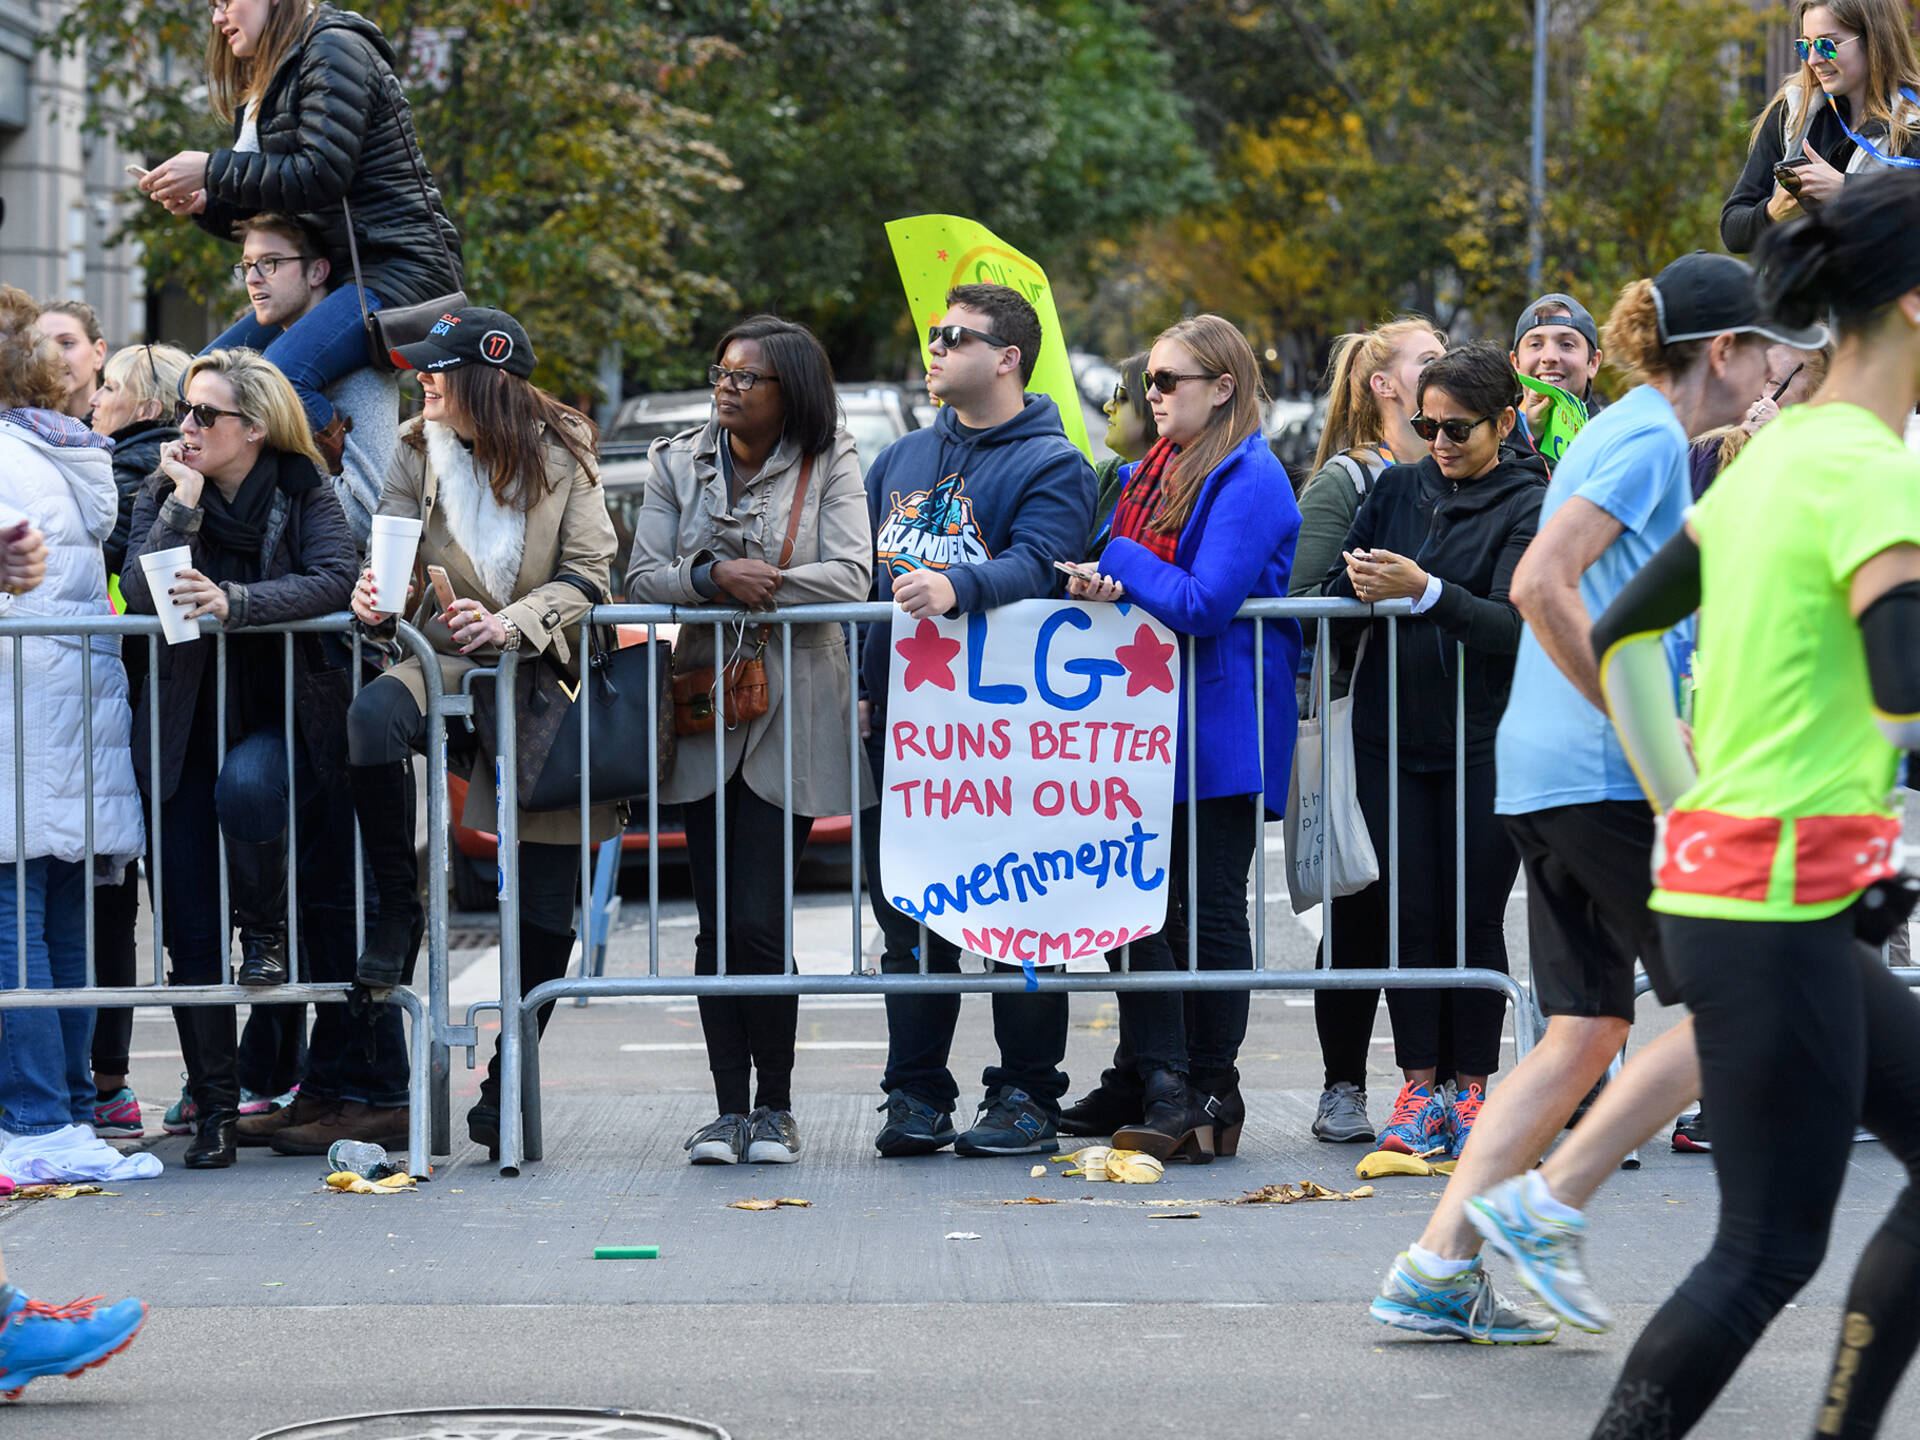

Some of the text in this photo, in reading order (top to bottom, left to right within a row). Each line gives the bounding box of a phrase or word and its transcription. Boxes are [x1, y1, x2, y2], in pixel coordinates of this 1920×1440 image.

[489, 335, 507, 359] 17
[967, 607, 1126, 711] LG
[892, 719, 1171, 764] RUNS BETTER
[890, 775, 1143, 820] THAN OUR
[892, 821, 1165, 926] government
